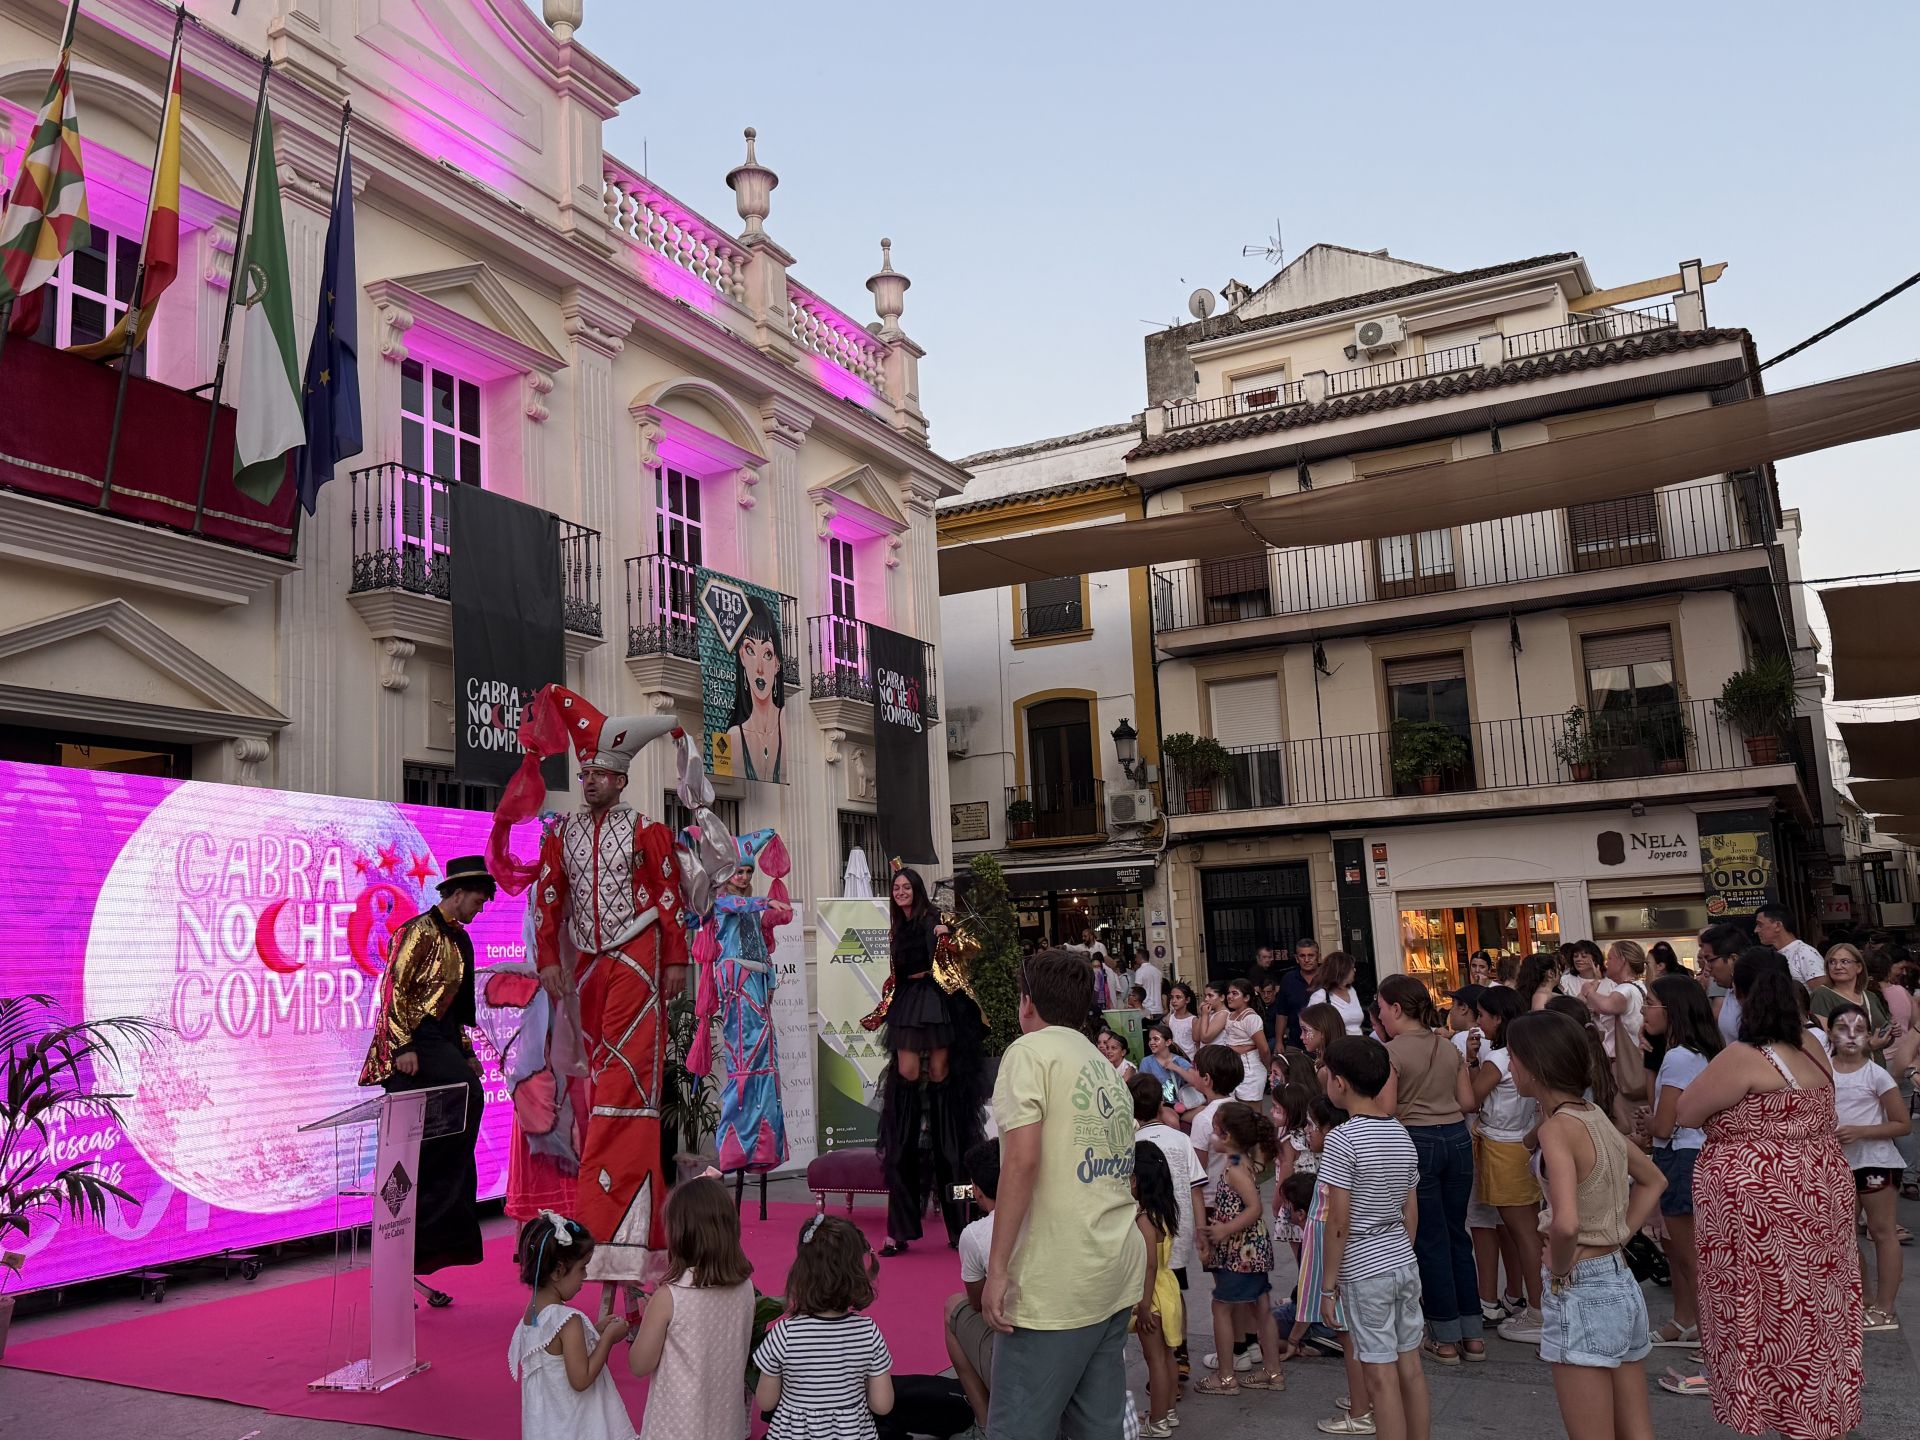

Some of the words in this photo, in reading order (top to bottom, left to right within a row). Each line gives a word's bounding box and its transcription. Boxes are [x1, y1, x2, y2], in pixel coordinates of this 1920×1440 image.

[708, 665, 737, 682] CIUDAD
[878, 667, 906, 692] CABRA
[466, 677, 520, 708] CABRA
[708, 681, 724, 693] DEL
[879, 685, 909, 709] NOCHE
[466, 700, 524, 731] NOCHE
[880, 703, 923, 733] COMPRAS
[1629, 832, 1687, 850] NELA
[1647, 849, 1688, 861] Joyeros
[176, 831, 349, 901] CABRA
[1116, 869, 1141, 877] sentir
[1713, 868, 1764, 887] ORO
[176, 897, 357, 973] NOCHE
[775, 963, 797, 974] LAR
[830, 955, 874, 964] AECA
[774, 999, 804, 1007] NGULAR
[1075, 1126, 1106, 1137] SINCE
[40, 1126, 121, 1167] deseas,
[378, 1216, 412, 1234] Ayuntamiento
[391, 1227, 405, 1238] Cabra
